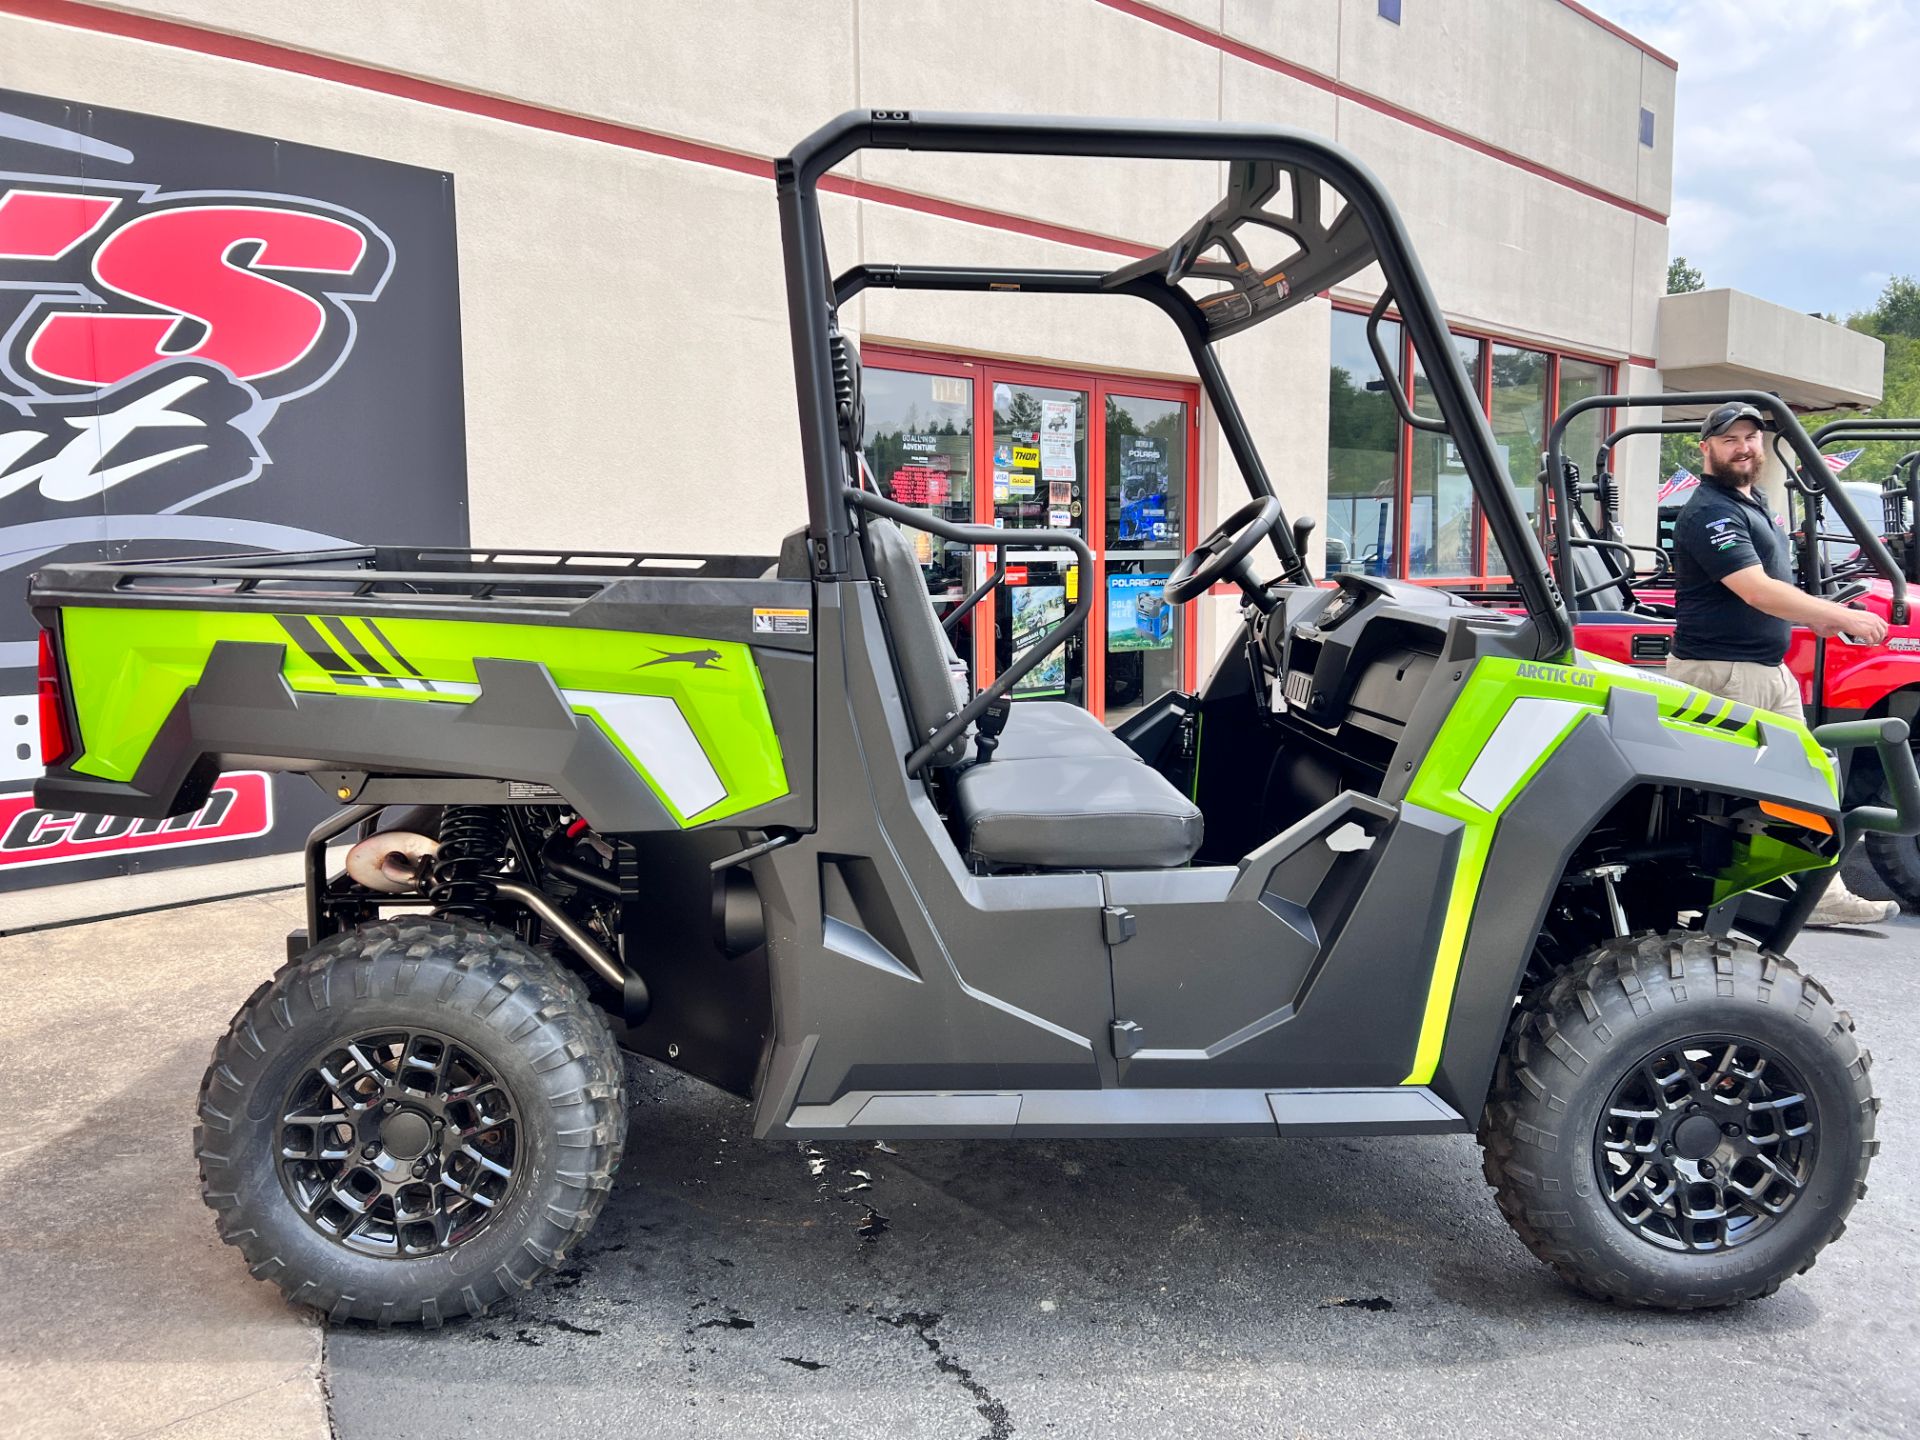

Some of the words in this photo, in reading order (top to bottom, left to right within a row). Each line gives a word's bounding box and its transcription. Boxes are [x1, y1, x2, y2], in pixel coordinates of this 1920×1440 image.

[902, 443, 936, 452] ADVENTURE
[1015, 451, 1037, 461] THOR
[1128, 450, 1160, 458] POLARIS
[1111, 579, 1149, 587] POLARIS
[1111, 600, 1133, 608] SOLD
[1516, 662, 1567, 683] ARCTIC
[1570, 672, 1596, 688] CAT
